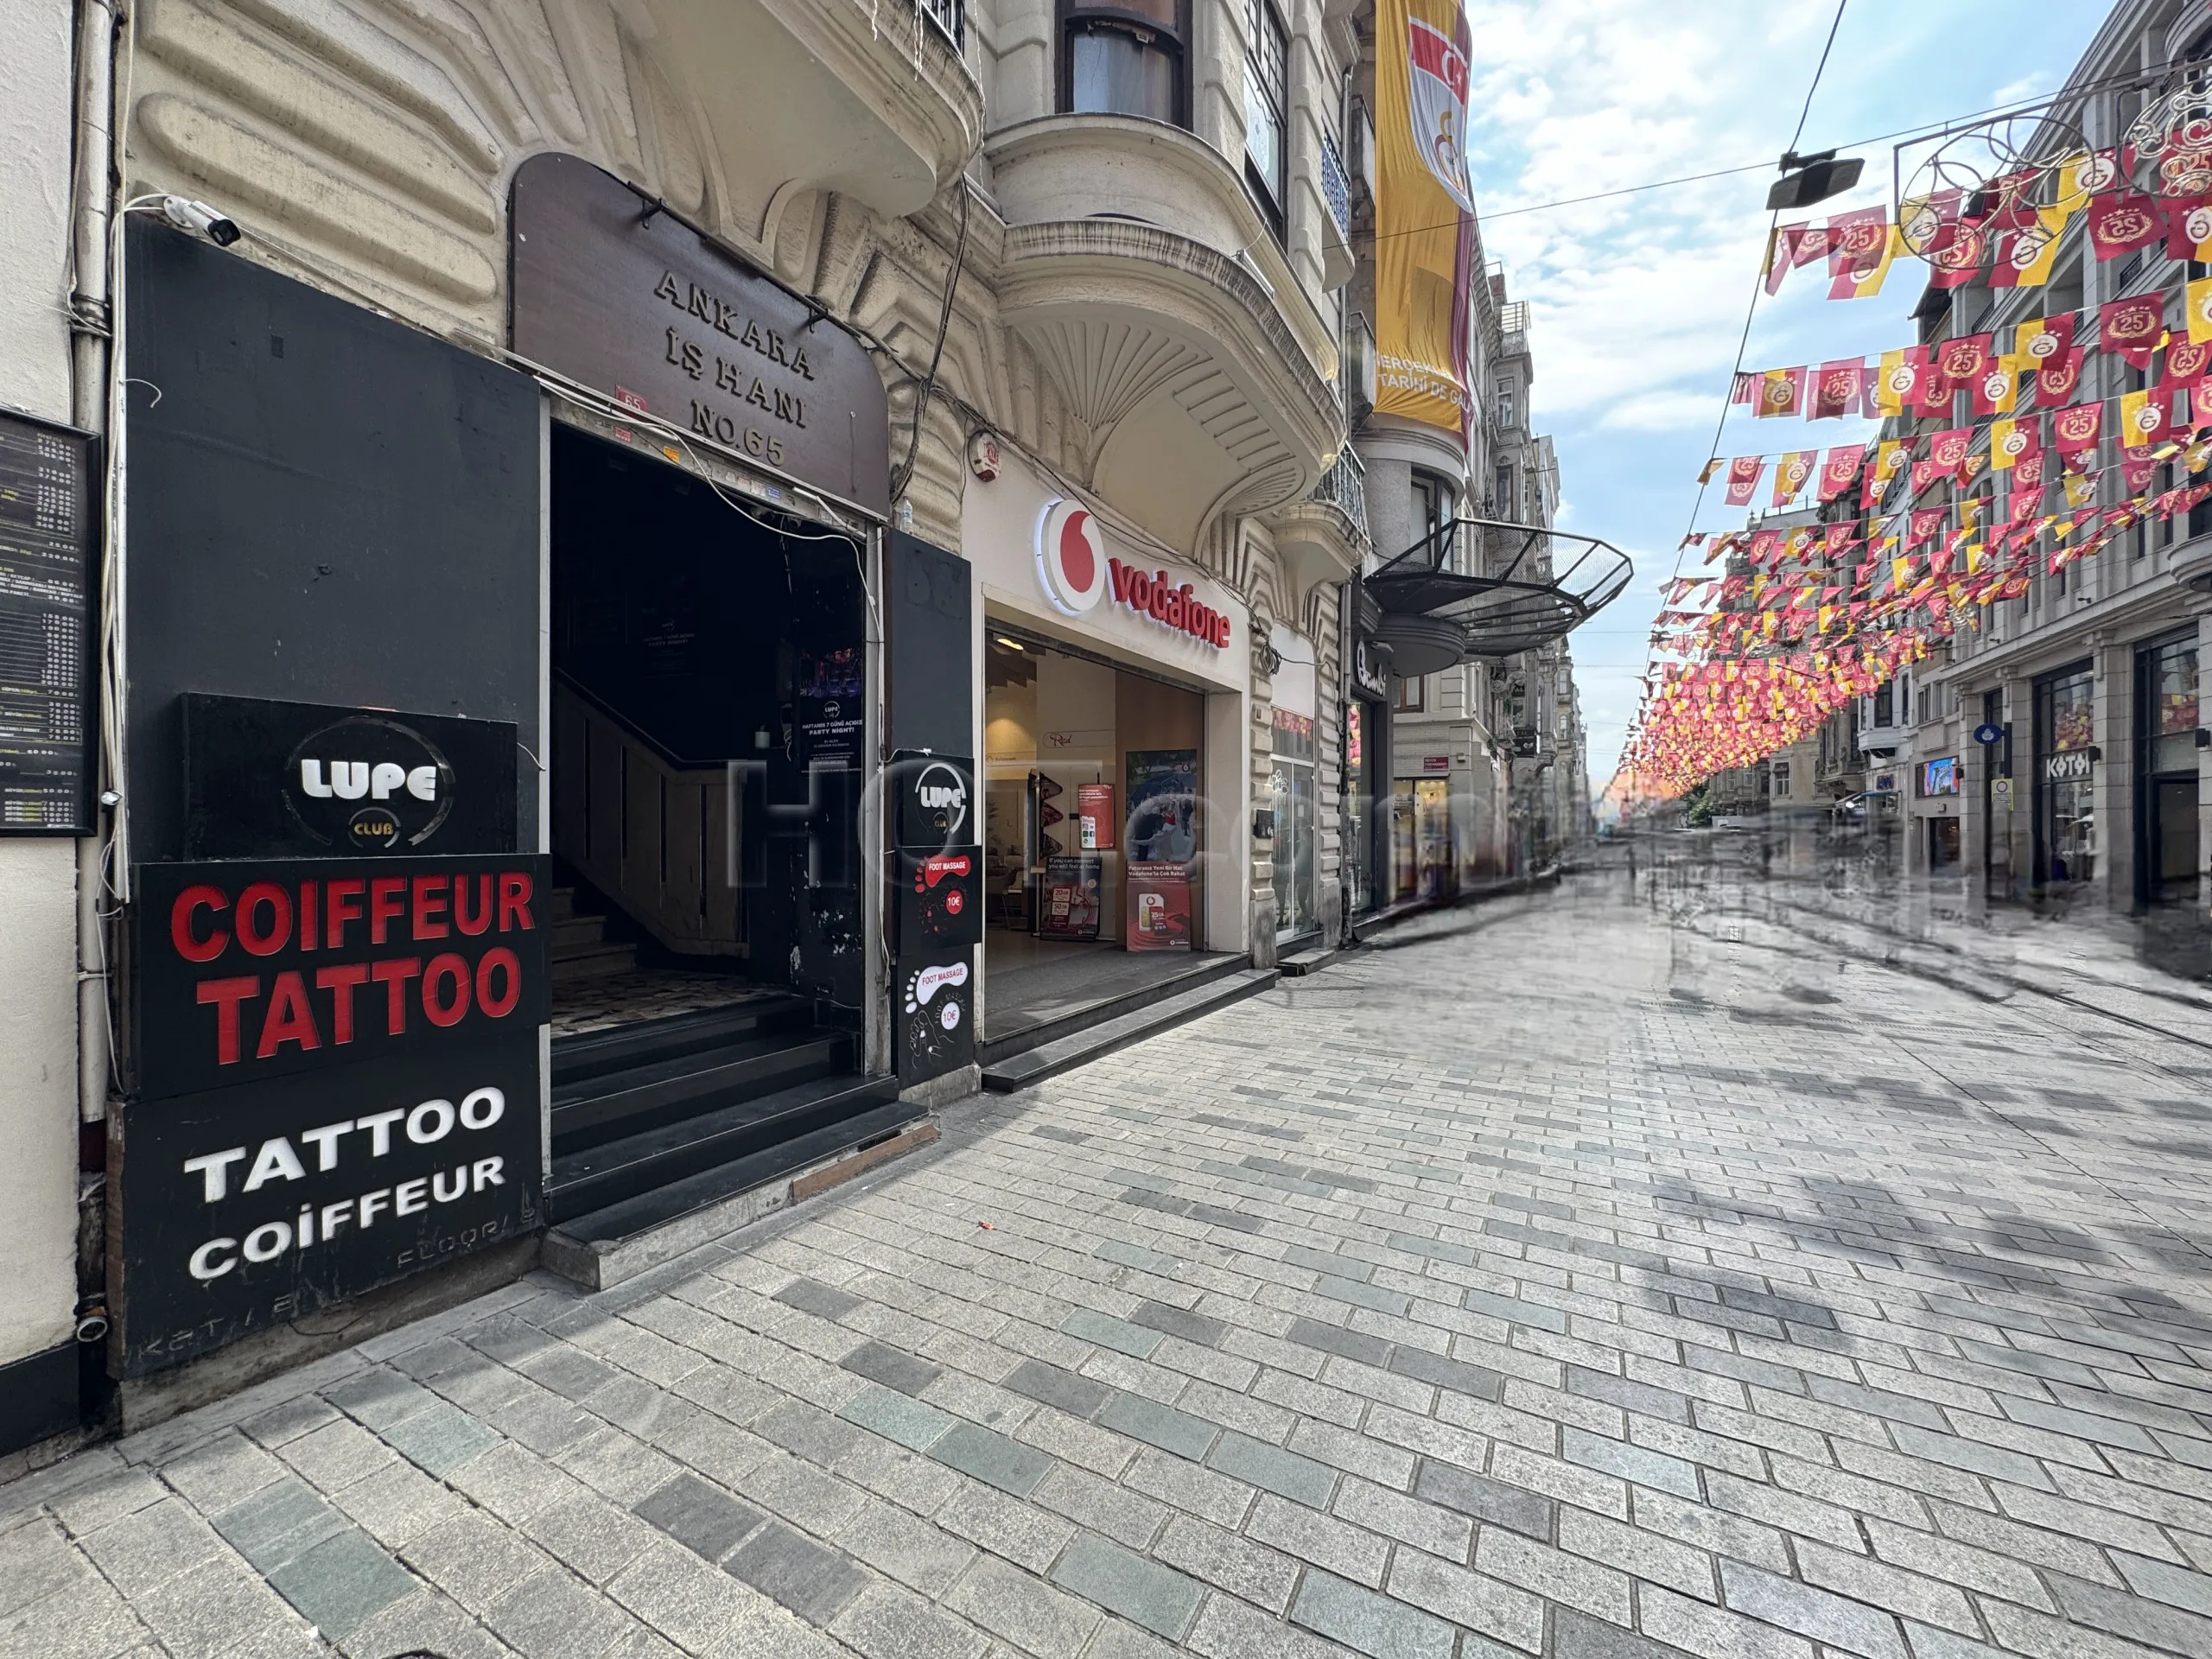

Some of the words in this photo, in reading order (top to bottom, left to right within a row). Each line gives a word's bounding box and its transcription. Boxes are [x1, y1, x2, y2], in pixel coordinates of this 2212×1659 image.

[653, 270, 815, 381] ANKARA
[2120, 315, 2144, 331] 25
[1953, 354, 1971, 371] 25
[665, 325, 705, 380] İŞ
[715, 356, 807, 429] HANI
[1378, 373, 1427, 393] TARİHİ
[1431, 381, 1448, 400] DE
[1831, 381, 1849, 397] 25
[690, 398, 785, 467] NO.65
[2069, 419, 2089, 433] 25
[1944, 445, 1960, 460] 25
[1837, 462, 1852, 475] 25
[1108, 557, 1230, 648] vodafone
[1049, 733, 1072, 747] Red
[301, 759, 436, 801] LUPE
[921, 786, 963, 808] LUPE
[354, 822, 394, 837] CLUB
[928, 863, 943, 871] FOOT
[943, 861, 966, 871] MASSAGE
[947, 896, 961, 906] 10€
[170, 872, 535, 963] COIFFEUR
[922, 974, 937, 985] FOOT
[938, 967, 963, 980] MASSAGE
[196, 947, 521, 1065] TATTOO
[943, 1010, 957, 1022] 10€
[184, 1087, 505, 1204] TATTOO
[189, 1156, 506, 1281] COİFFEUR
